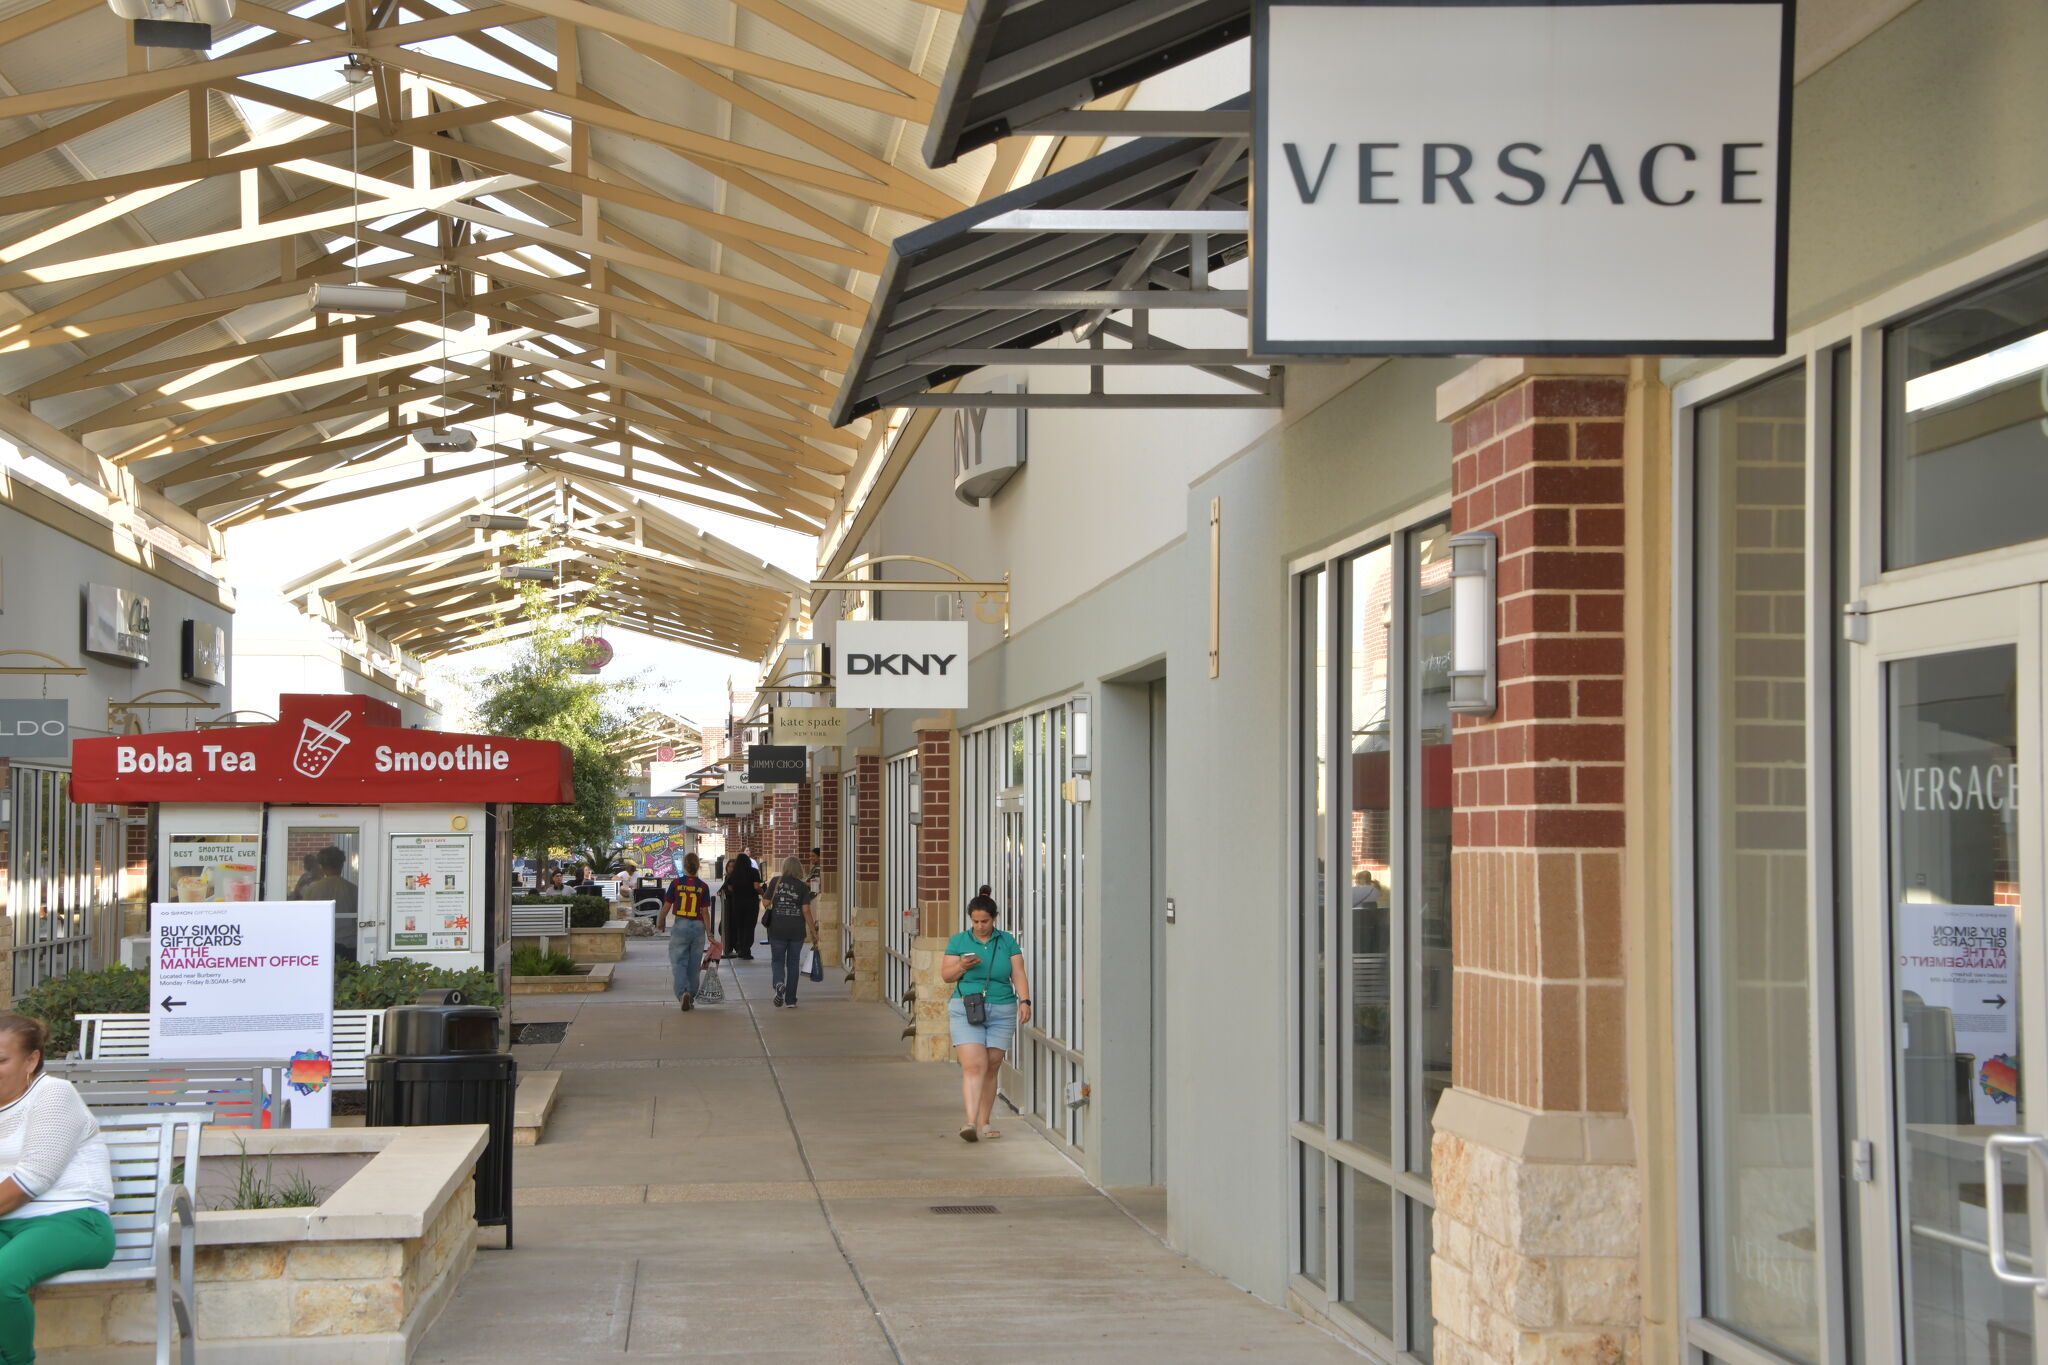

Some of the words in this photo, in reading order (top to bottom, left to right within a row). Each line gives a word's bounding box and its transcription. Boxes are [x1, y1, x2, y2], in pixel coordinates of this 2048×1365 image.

[1282, 142, 1765, 207] VERSACE
[847, 653, 958, 676] DKNY
[780, 716, 804, 727] kate
[807, 716, 841, 730] spade
[117, 746, 193, 773] Boba
[202, 744, 256, 772] Tea
[375, 743, 509, 772] Smoothie
[751, 760, 775, 769] JIMMY
[776, 760, 804, 769] CHOO
[199, 854, 218, 862] BOBA
[219, 854, 233, 862] TEA
[677, 892, 698, 917] 11
[161, 925, 188, 937] BUY
[191, 924, 241, 936] SIMON
[160, 948, 179, 958] AT
[181, 947, 209, 958] THE
[160, 956, 267, 970] MANAGEMENT
[269, 955, 319, 968] OFFICE
[1732, 1235, 1819, 1304] VERSAC
